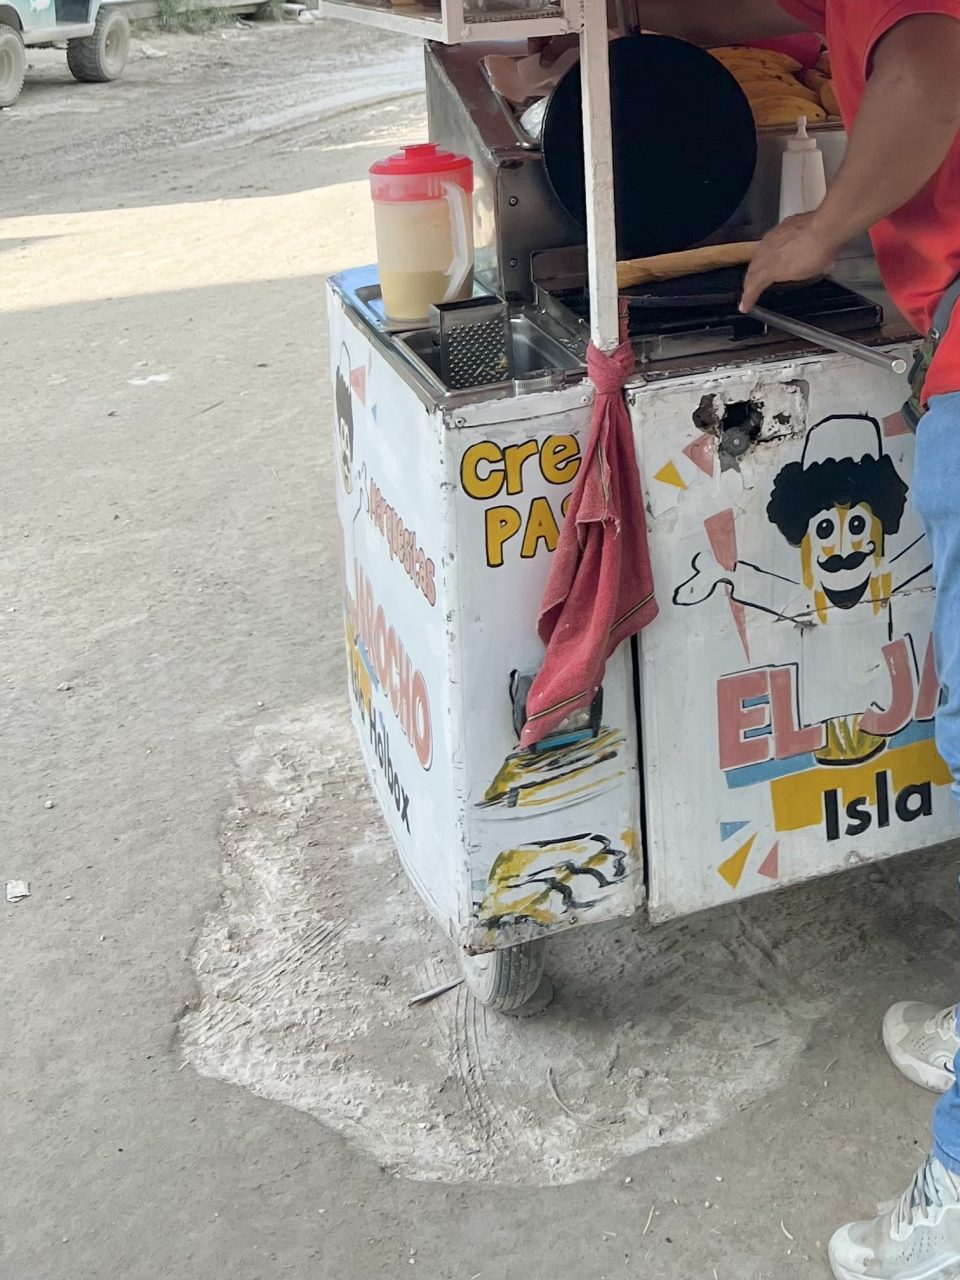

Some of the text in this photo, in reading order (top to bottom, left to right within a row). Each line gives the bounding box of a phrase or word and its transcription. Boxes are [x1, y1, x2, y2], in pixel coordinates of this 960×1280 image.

[485, 492, 573, 568] PA
[717, 663, 828, 772] EL
[369, 697, 412, 836] Holbox
[824, 770, 933, 842] Isla
